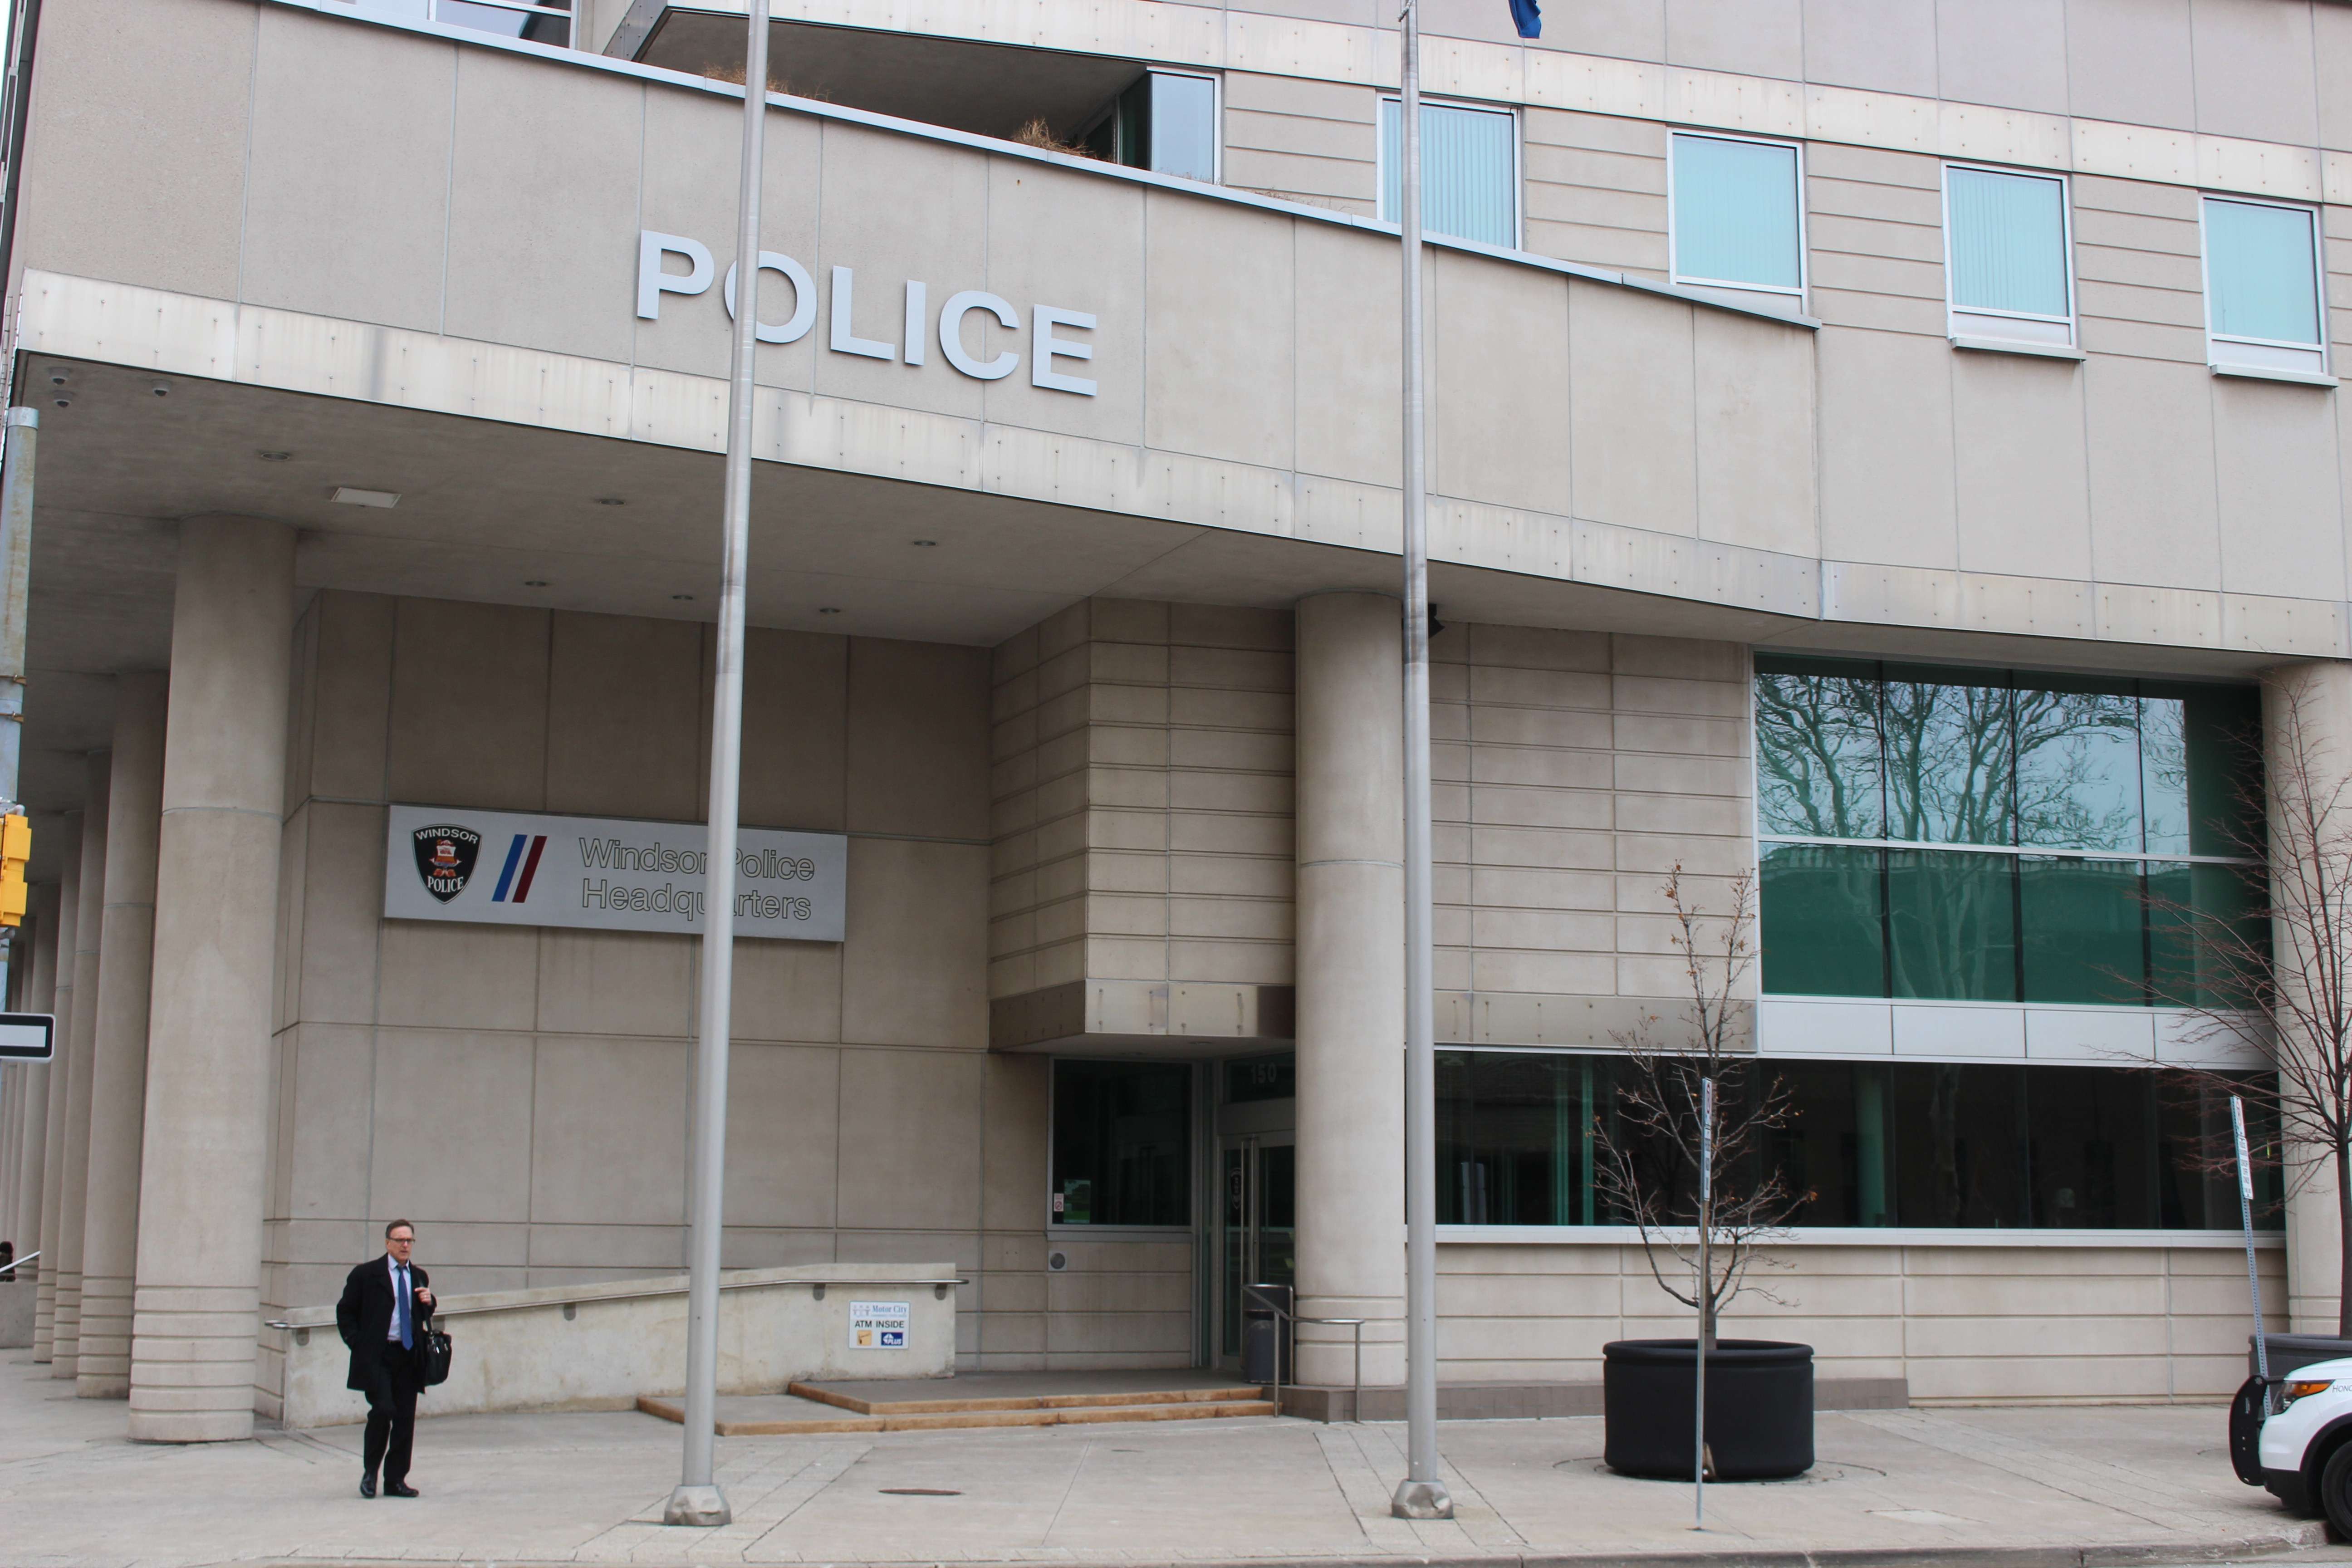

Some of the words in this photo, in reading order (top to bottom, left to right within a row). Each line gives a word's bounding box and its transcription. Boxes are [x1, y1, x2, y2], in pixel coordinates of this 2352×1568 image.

[637, 229, 1098, 397] POLICE
[415, 828, 478, 844] WINDSOR
[579, 838, 707, 874] Windsor
[427, 875, 464, 893] POLICE
[583, 878, 812, 921] Headqrters
